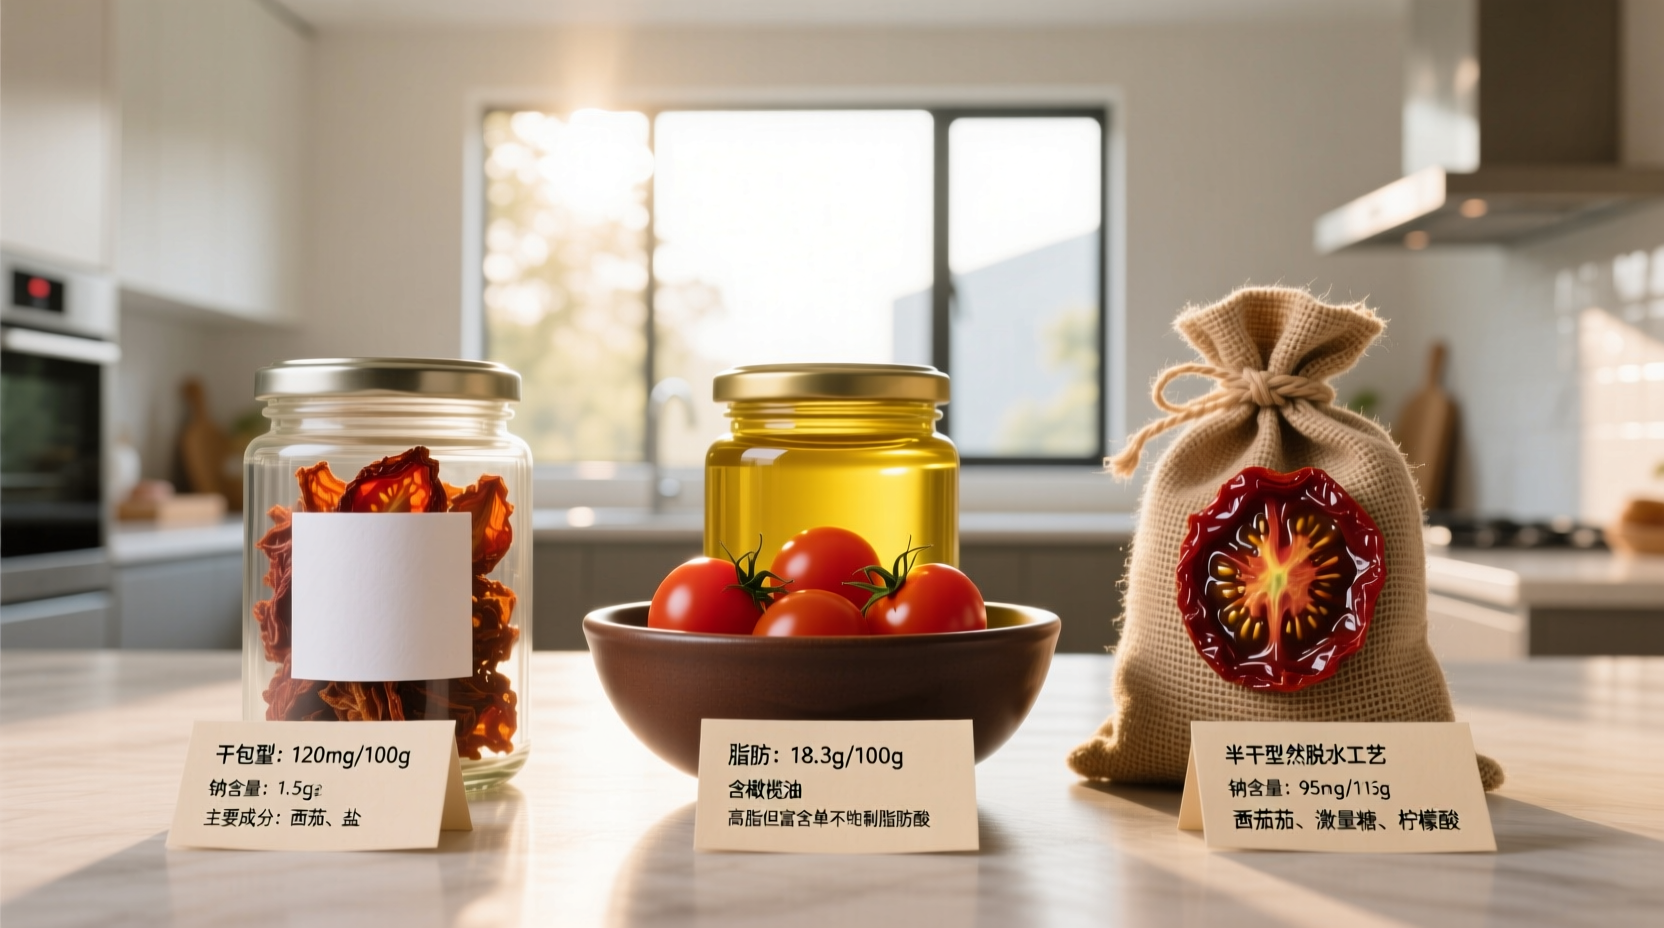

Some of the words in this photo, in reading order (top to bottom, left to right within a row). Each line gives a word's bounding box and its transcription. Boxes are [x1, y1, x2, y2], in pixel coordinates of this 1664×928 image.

[1225, 743, 1387, 766] 半干型然脱水工艺
